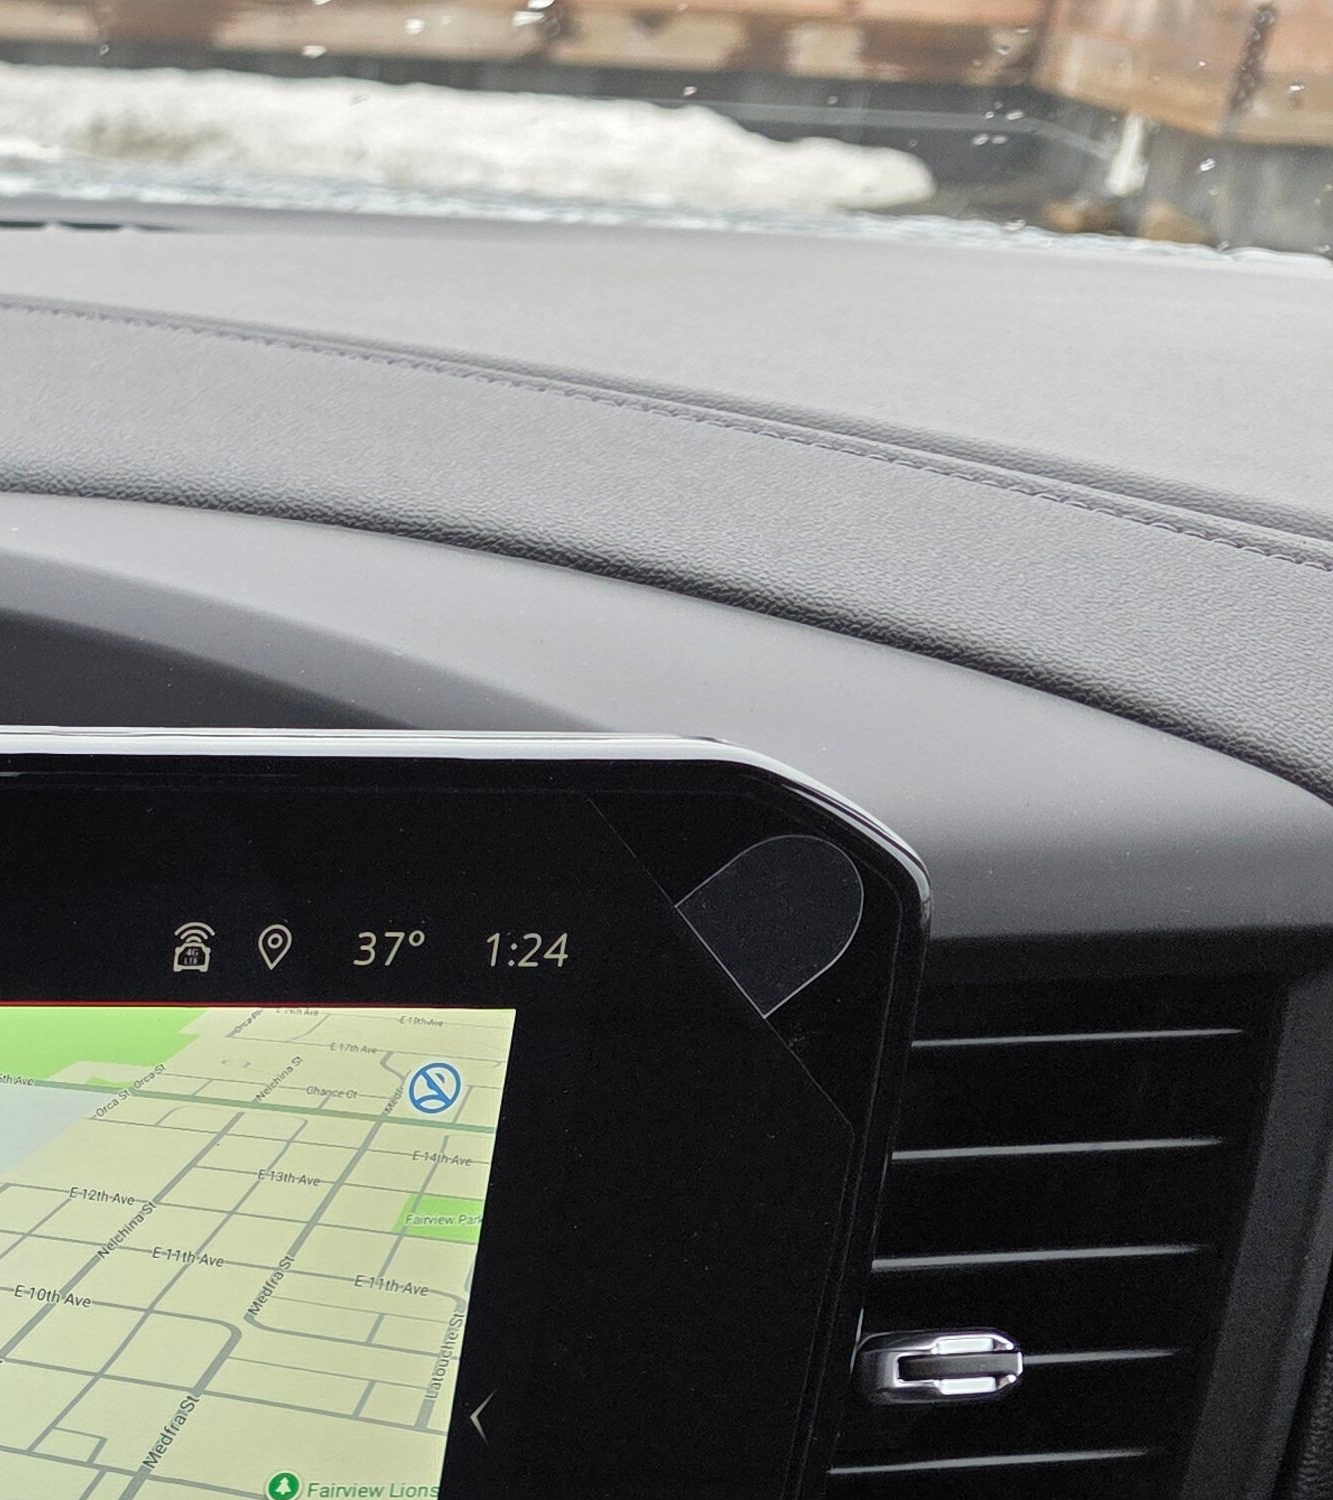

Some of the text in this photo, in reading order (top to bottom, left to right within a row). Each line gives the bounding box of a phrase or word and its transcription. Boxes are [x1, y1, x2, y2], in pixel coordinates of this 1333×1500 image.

[353, 930, 425, 967] 37°
[484, 932, 570, 969] 1:24
[12, 1076, 34, 1087] Ave
[133, 1063, 166, 1090] Orca St
[256, 1056, 303, 1102] Nelchina St
[95, 1089, 130, 1118] Orca St
[423, 1152, 448, 1165] 14th
[450, 1155, 472, 1167] Ave
[258, 1169, 321, 1187] E 13th Ave
[70, 1187, 135, 1206] E 12th Ave
[97, 1201, 157, 1260] Nelchina St
[405, 1213, 454, 1226] Fairview
[152, 1246, 225, 1268] E 11th Ave
[14, 1285, 92, 1308] E 10th Ave
[248, 1255, 294, 1316] Medfra St
[354, 1275, 429, 1297] E 11th Ave
[450, 1312, 466, 1328] St
[143, 1394, 199, 1469] Medfra St
[307, 1482, 439, 1498] Fairview Lions
